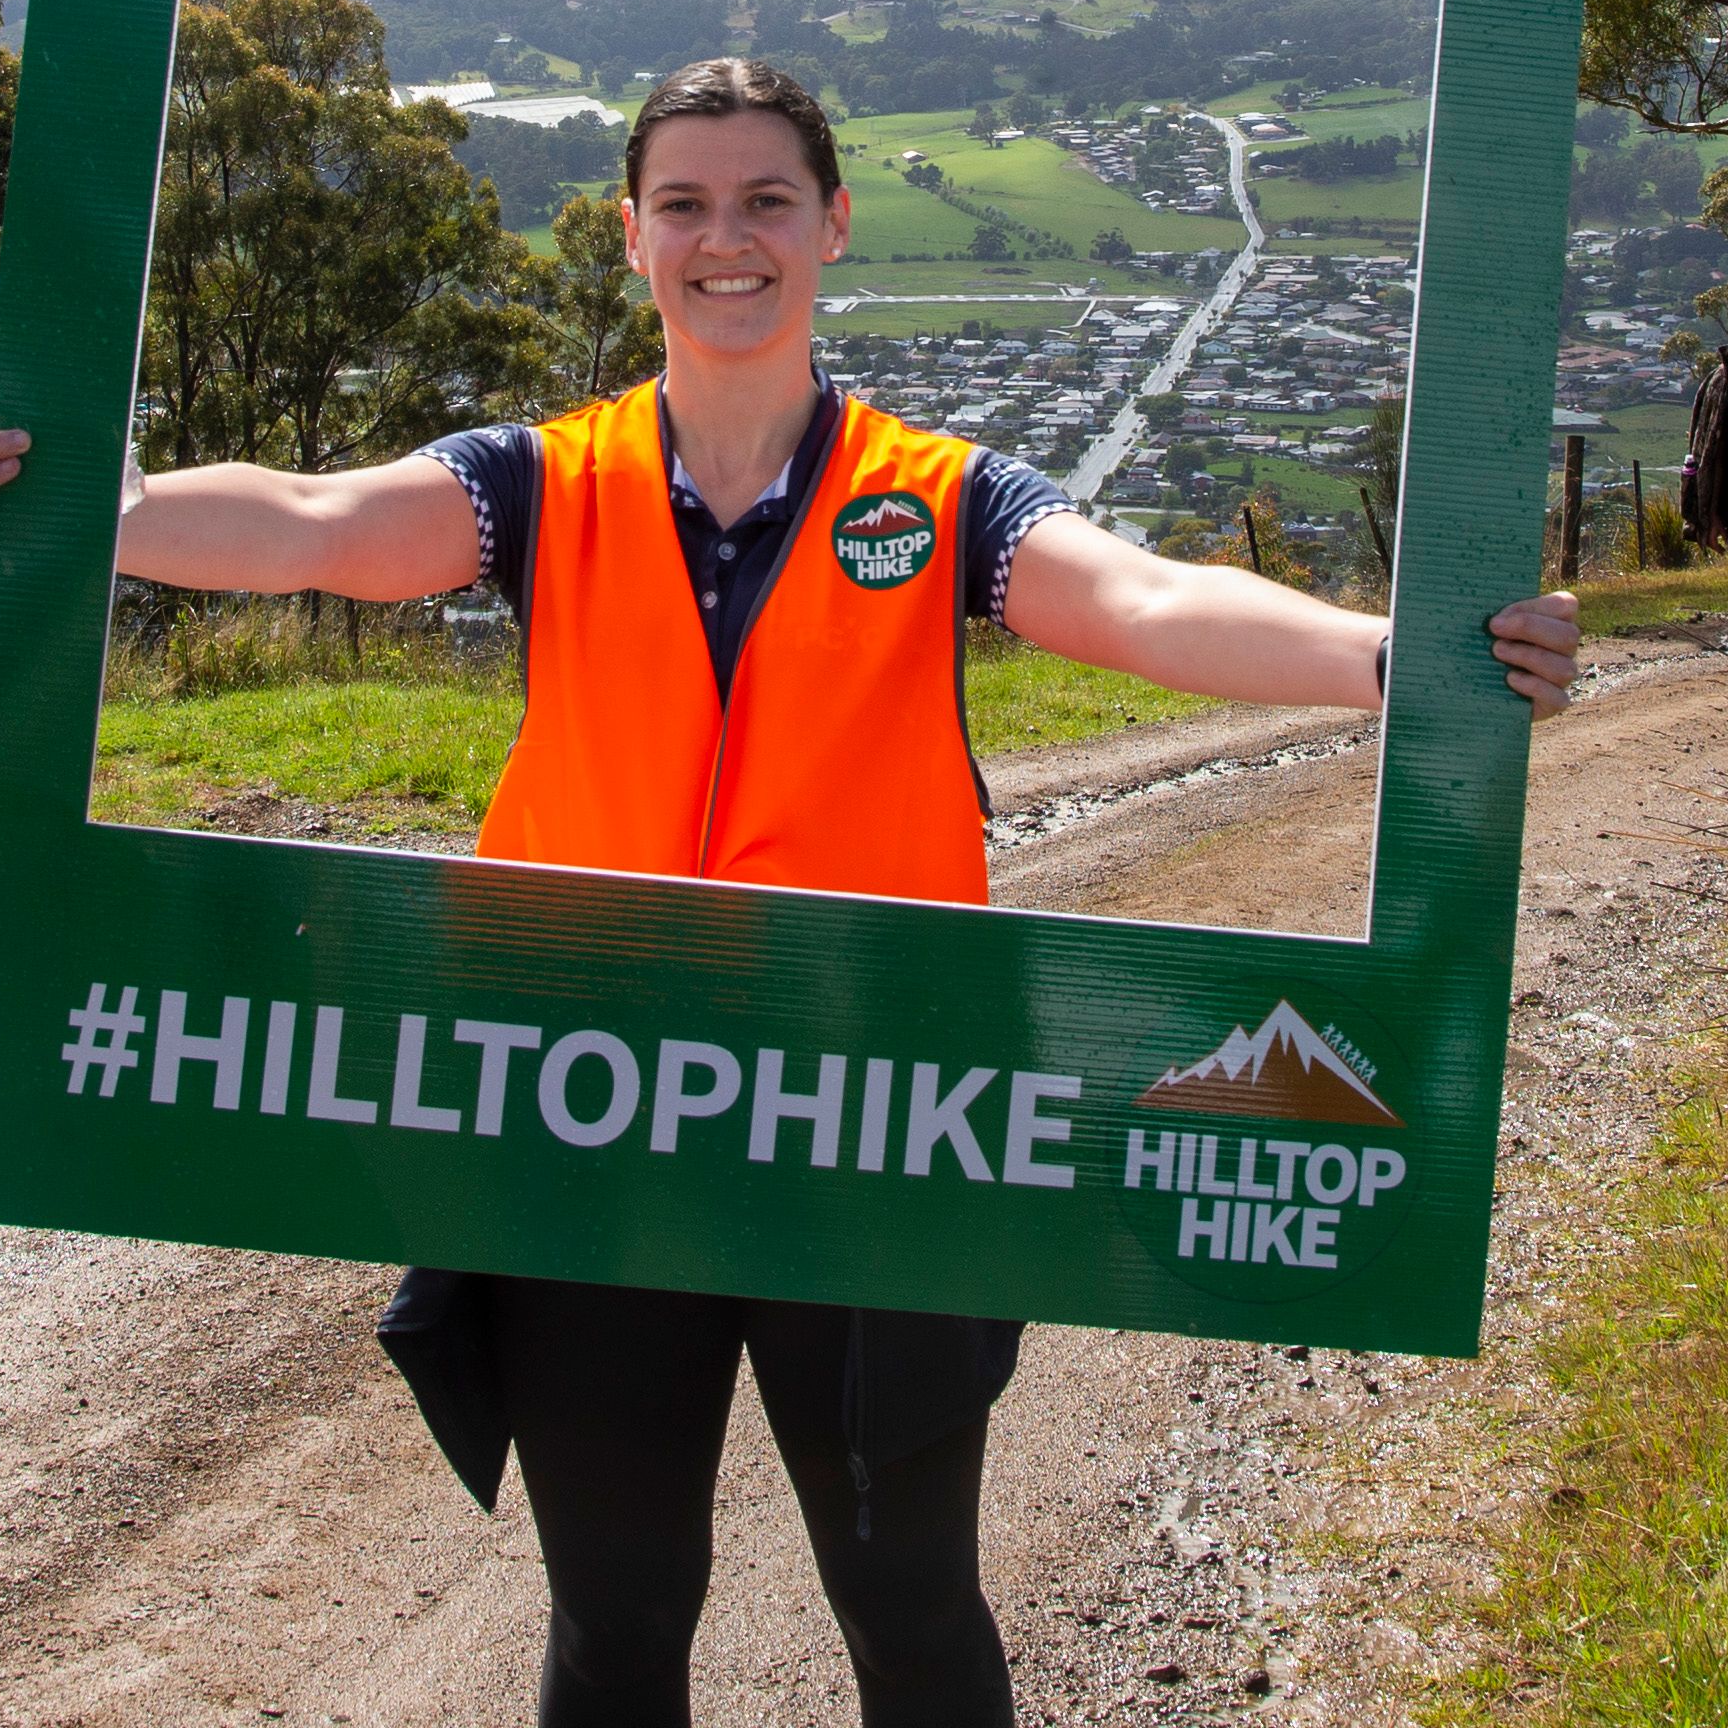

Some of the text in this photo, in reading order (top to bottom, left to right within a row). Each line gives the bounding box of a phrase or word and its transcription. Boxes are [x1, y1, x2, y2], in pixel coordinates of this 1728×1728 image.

[837, 531, 932, 561] HILLTOP
[857, 555, 914, 580] HIKE
[62, 982, 1083, 1189] #HILLTOPHIKE
[1124, 1128, 1407, 1207] HILLTOP
[1178, 1197, 1341, 1269] HIKE
